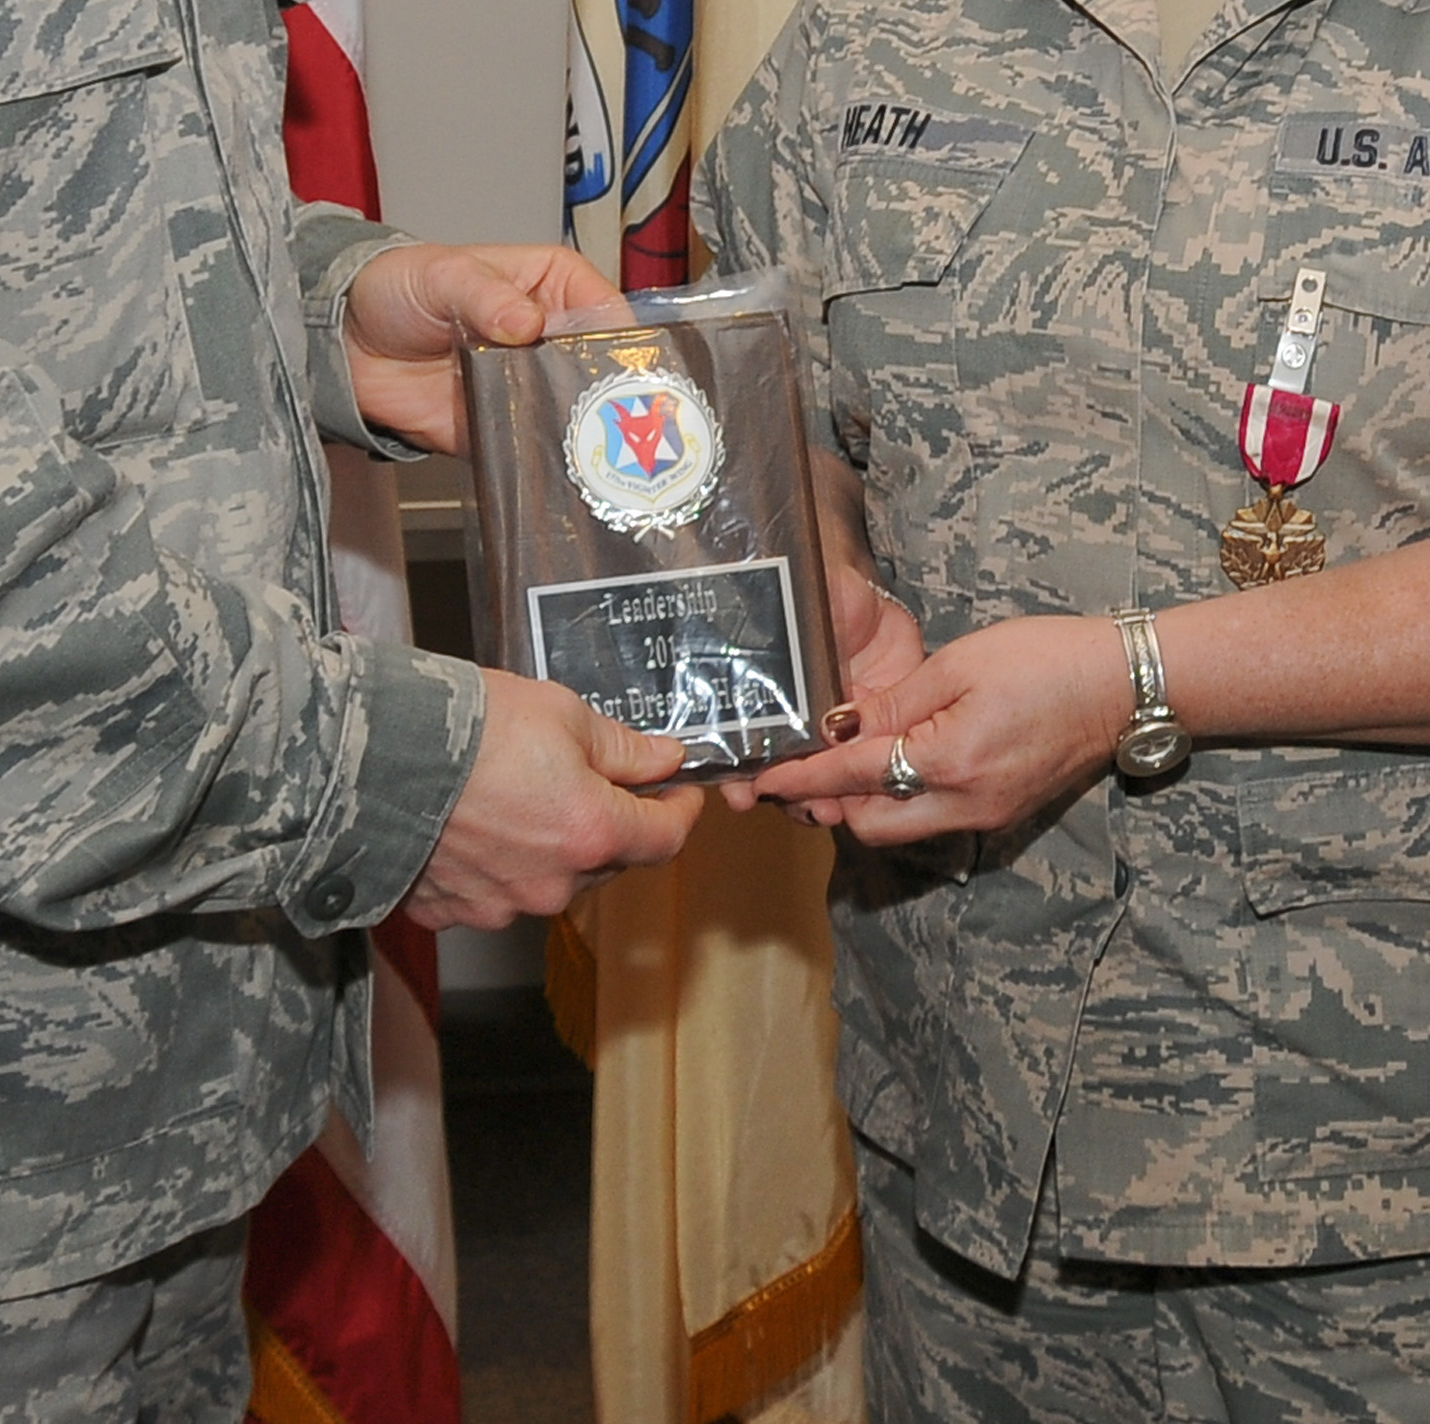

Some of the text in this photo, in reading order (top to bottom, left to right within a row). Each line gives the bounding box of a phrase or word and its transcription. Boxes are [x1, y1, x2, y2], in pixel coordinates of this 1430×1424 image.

[841, 104, 932, 151] HEATH
[1316, 128, 1387, 170] U.S.
[604, 581, 718, 625] Leadership
[578, 690, 624, 723] Sgt
